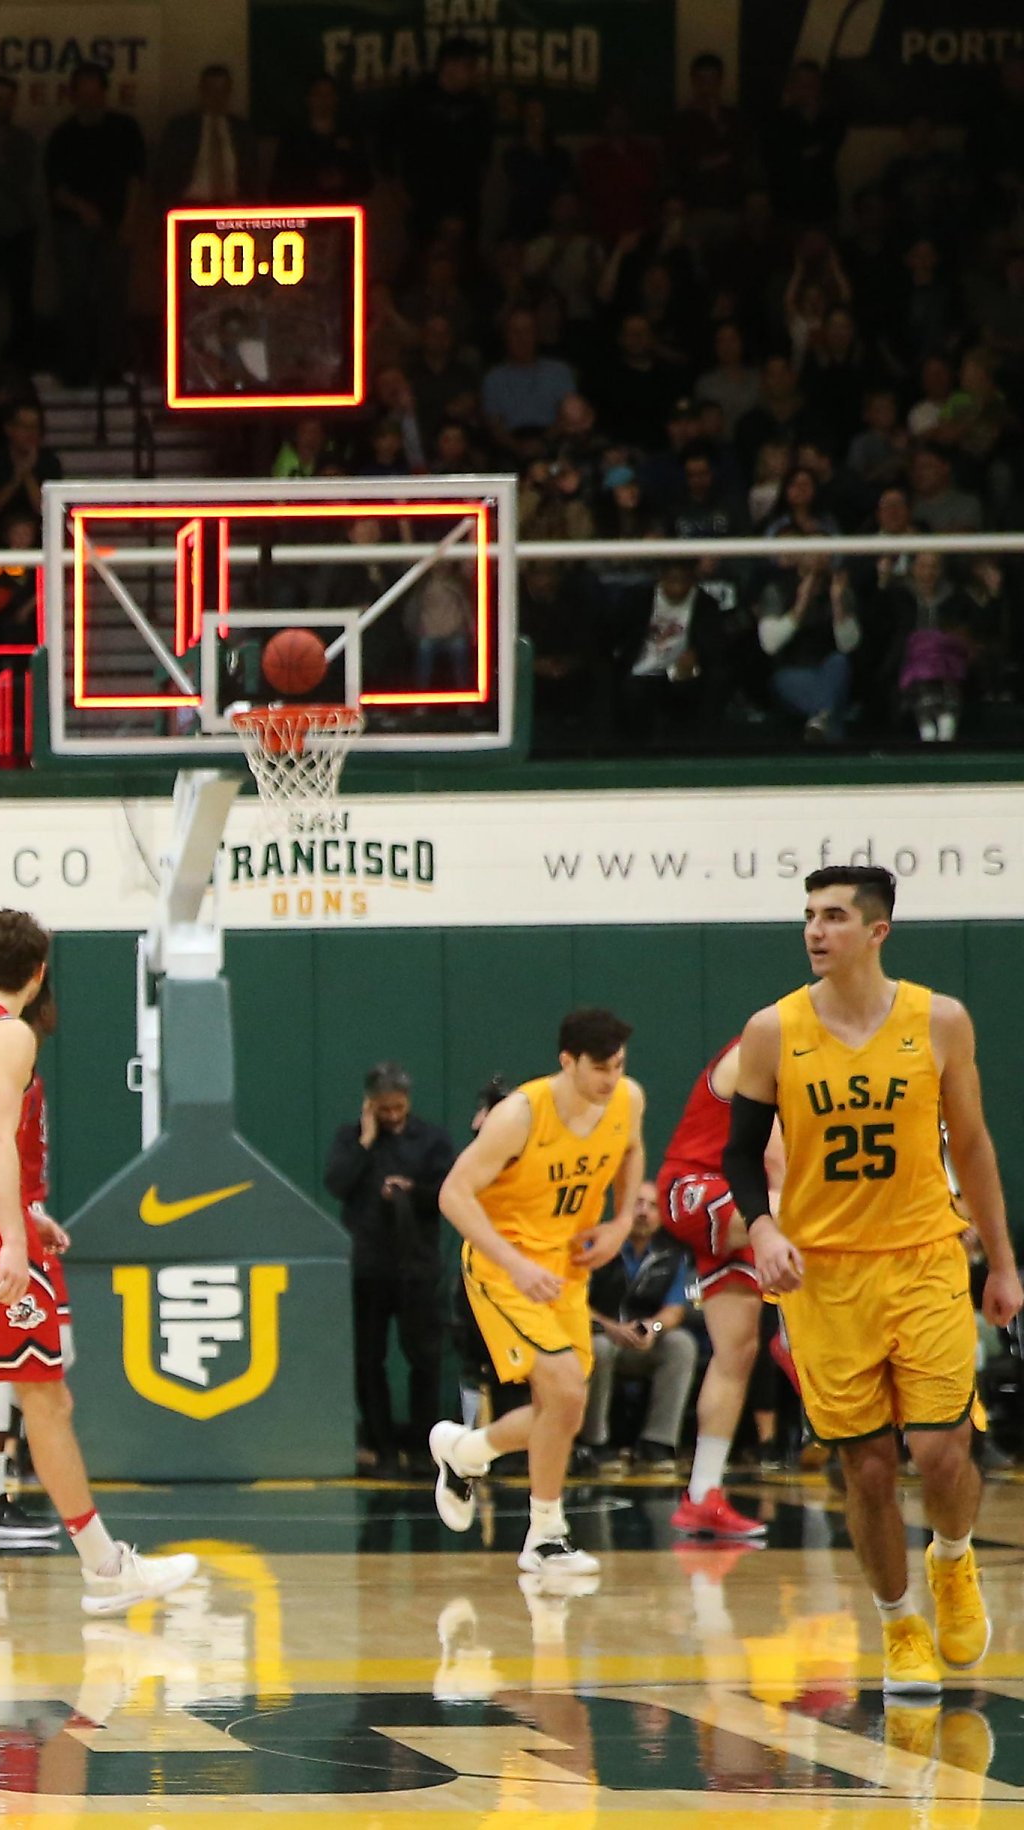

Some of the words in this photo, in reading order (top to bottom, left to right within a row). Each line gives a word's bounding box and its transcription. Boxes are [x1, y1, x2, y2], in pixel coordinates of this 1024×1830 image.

[190, 231, 304, 286] 00.0
[209, 839, 435, 884] RANCISCO
[272, 889, 368, 917] DONS
[823, 1123, 897, 1183] 25
[551, 1184, 589, 1218] 10
